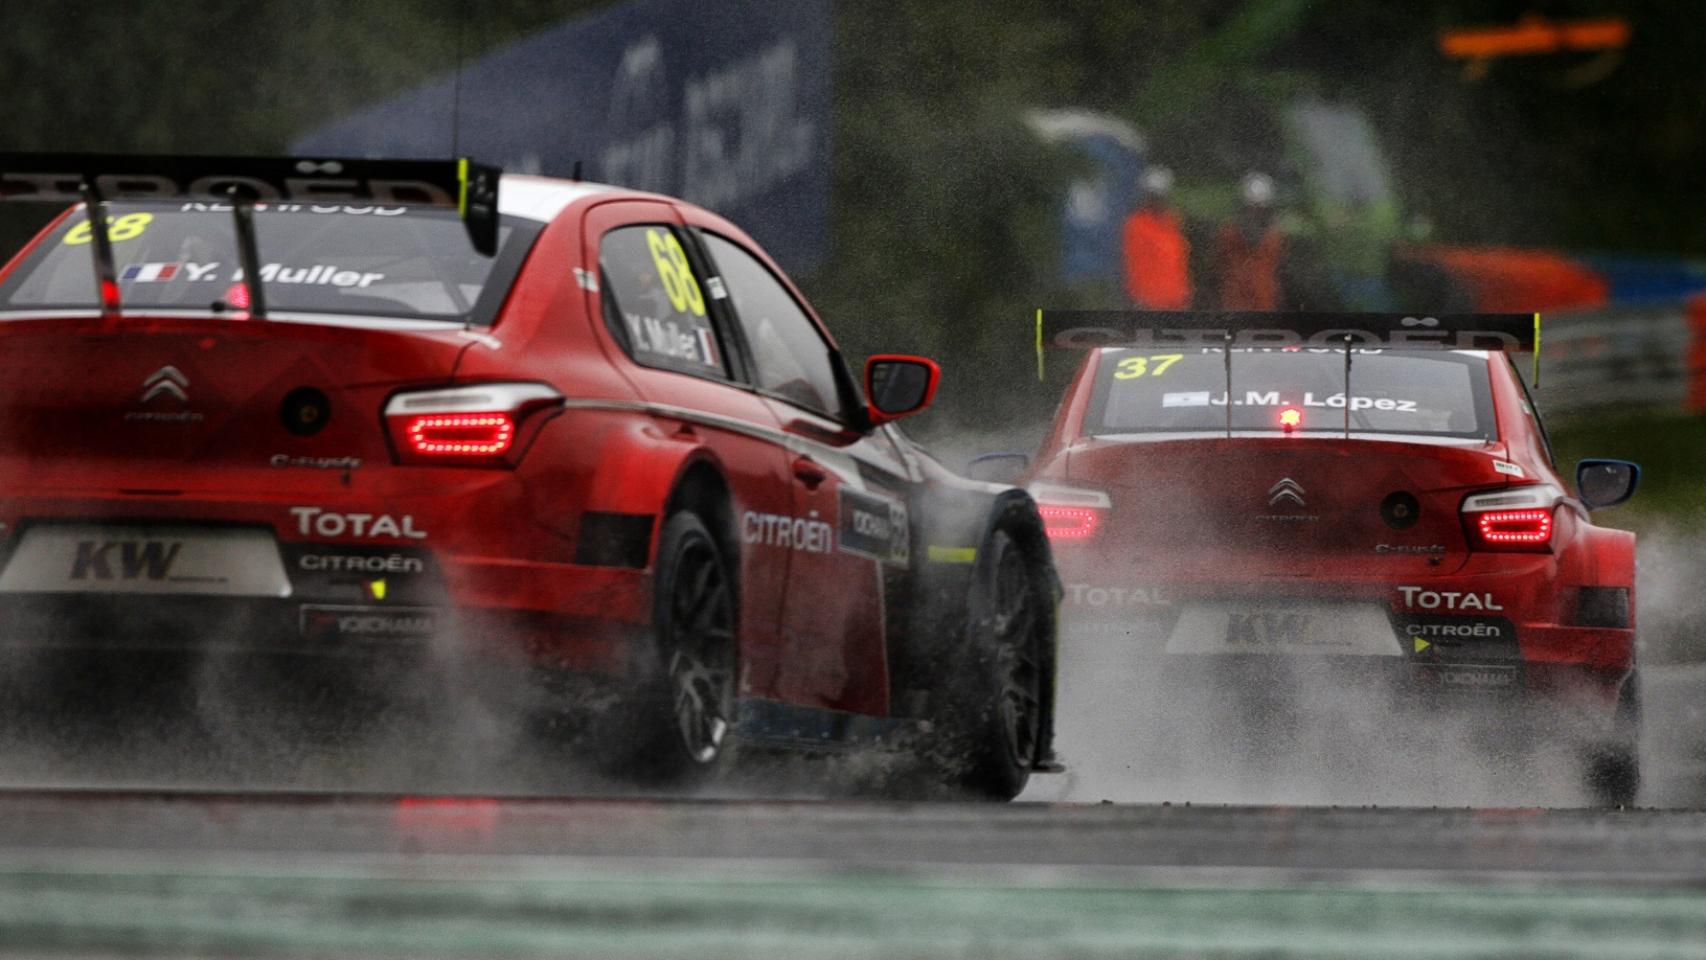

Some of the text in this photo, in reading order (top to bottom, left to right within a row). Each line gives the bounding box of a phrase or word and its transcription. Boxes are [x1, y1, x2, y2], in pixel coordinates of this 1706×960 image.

[63, 212, 154, 245] 68
[232, 263, 384, 287] Muller
[646, 228, 705, 317] 68
[1114, 354, 1183, 379] 37
[1303, 392, 1417, 412] López
[68, 541, 183, 580] KW
